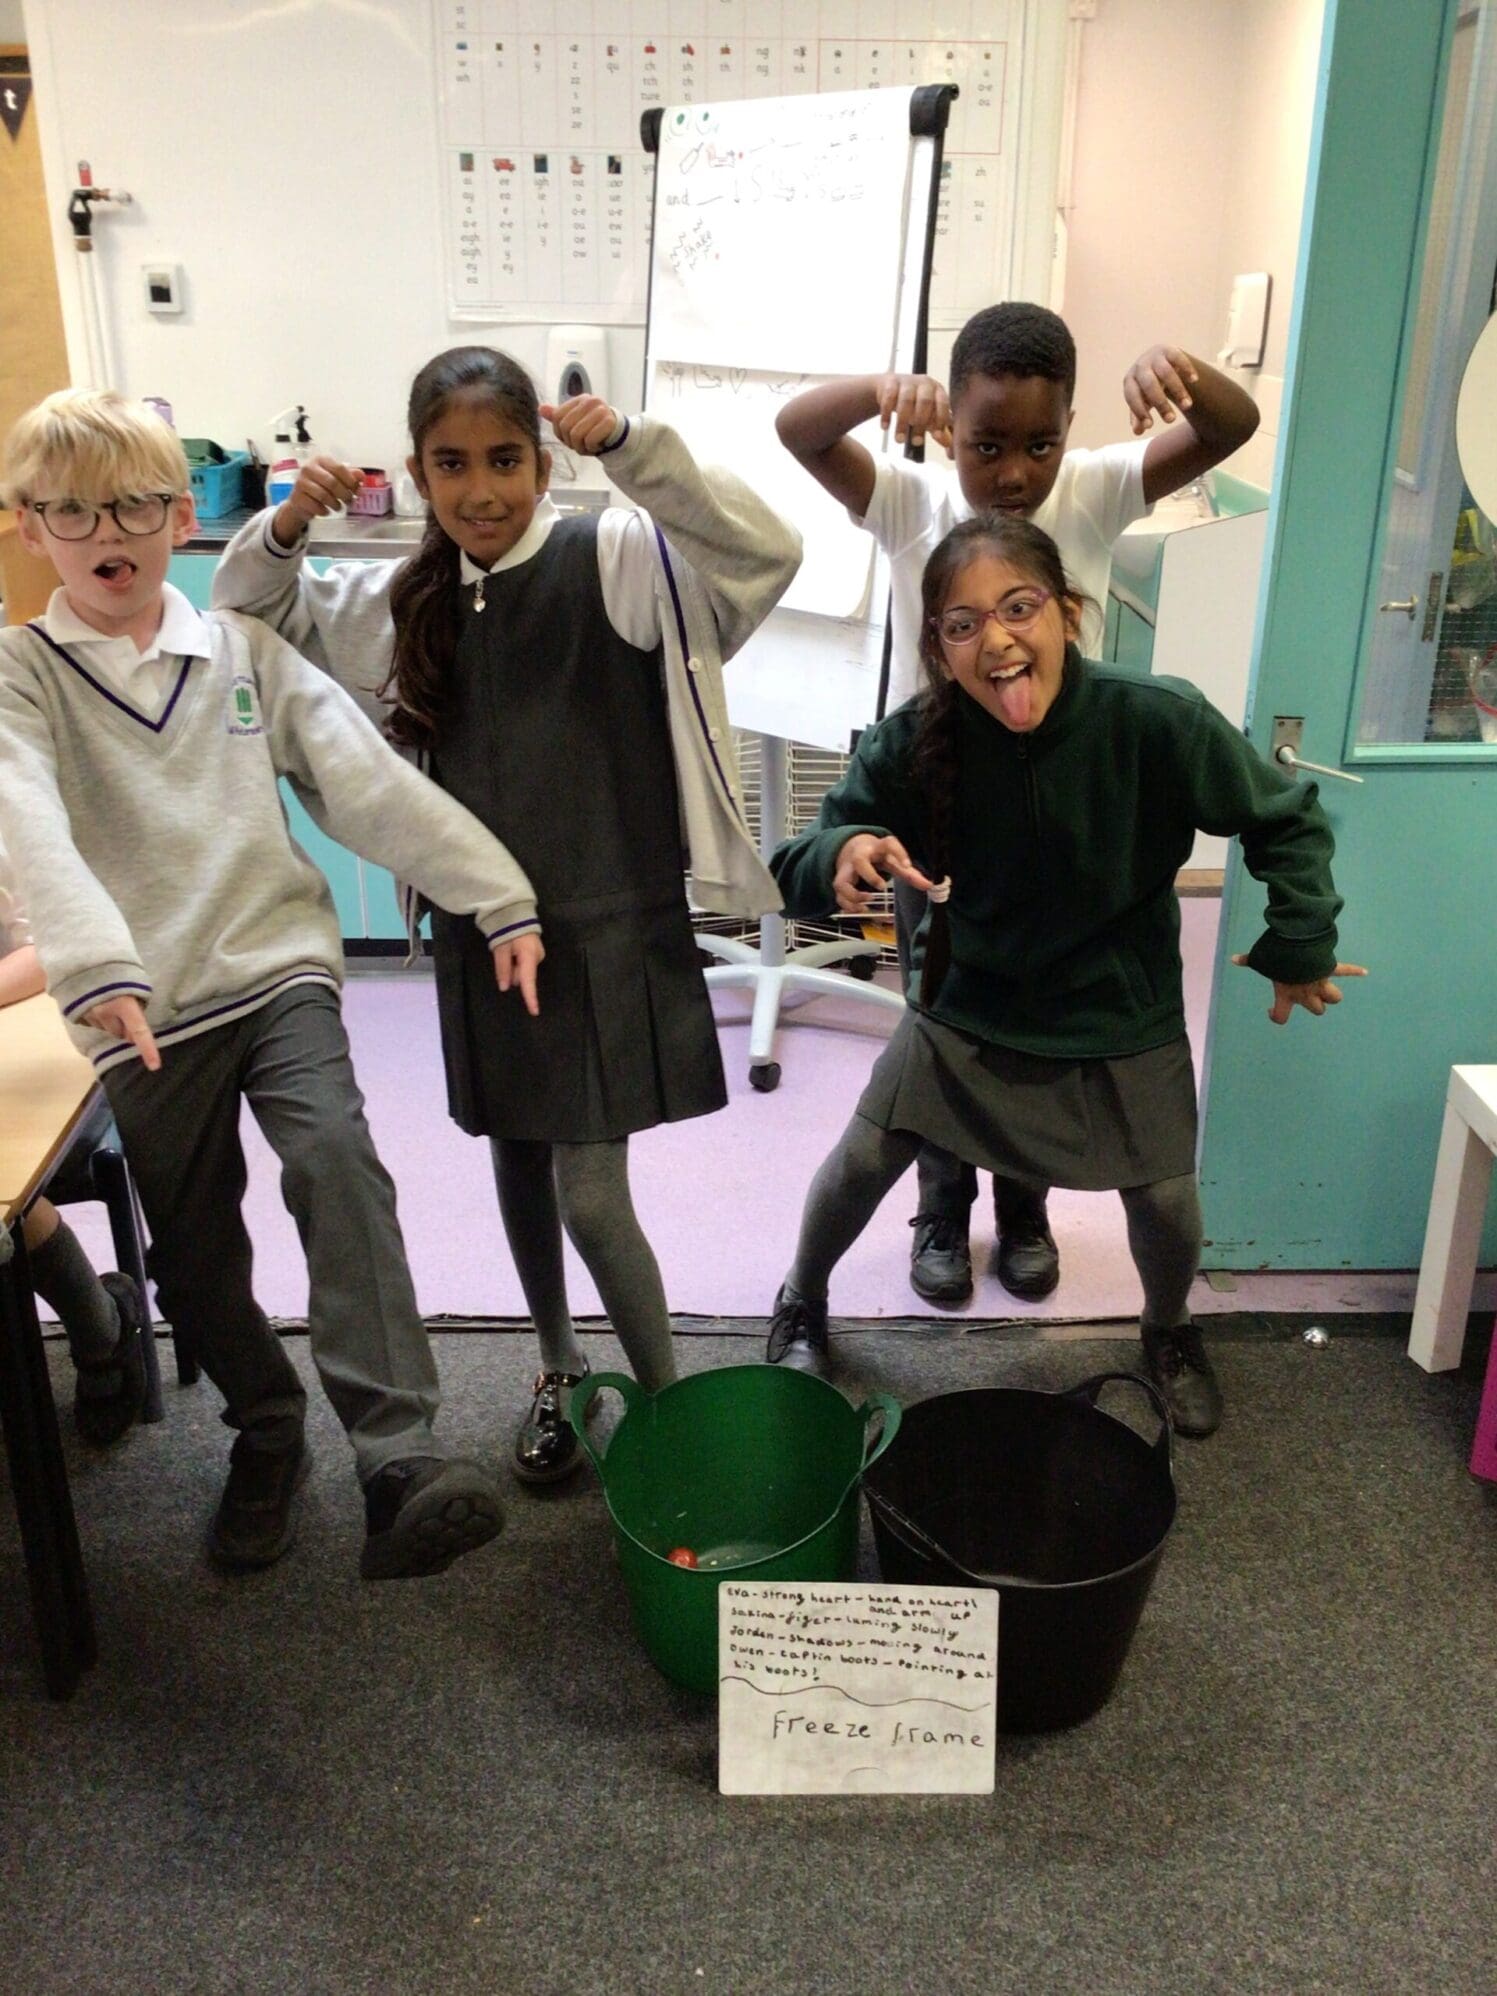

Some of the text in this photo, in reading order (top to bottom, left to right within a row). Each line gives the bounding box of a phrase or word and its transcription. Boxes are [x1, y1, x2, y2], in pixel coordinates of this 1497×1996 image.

[4, 88, 18, 111] t
[666, 186, 690, 207] and
[761, 1590, 805, 1606] strong
[811, 1591, 851, 1604] heart
[868, 1594, 902, 1605] hand
[908, 1598, 925, 1606] on
[869, 1606, 896, 1616] and
[902, 1609, 932, 1618] arm
[870, 1638, 923, 1654] moing
[933, 1645, 986, 1660] around
[734, 1659, 755, 1671] his
[840, 1654, 878, 1665] boots
[891, 1721, 985, 1748] frame
